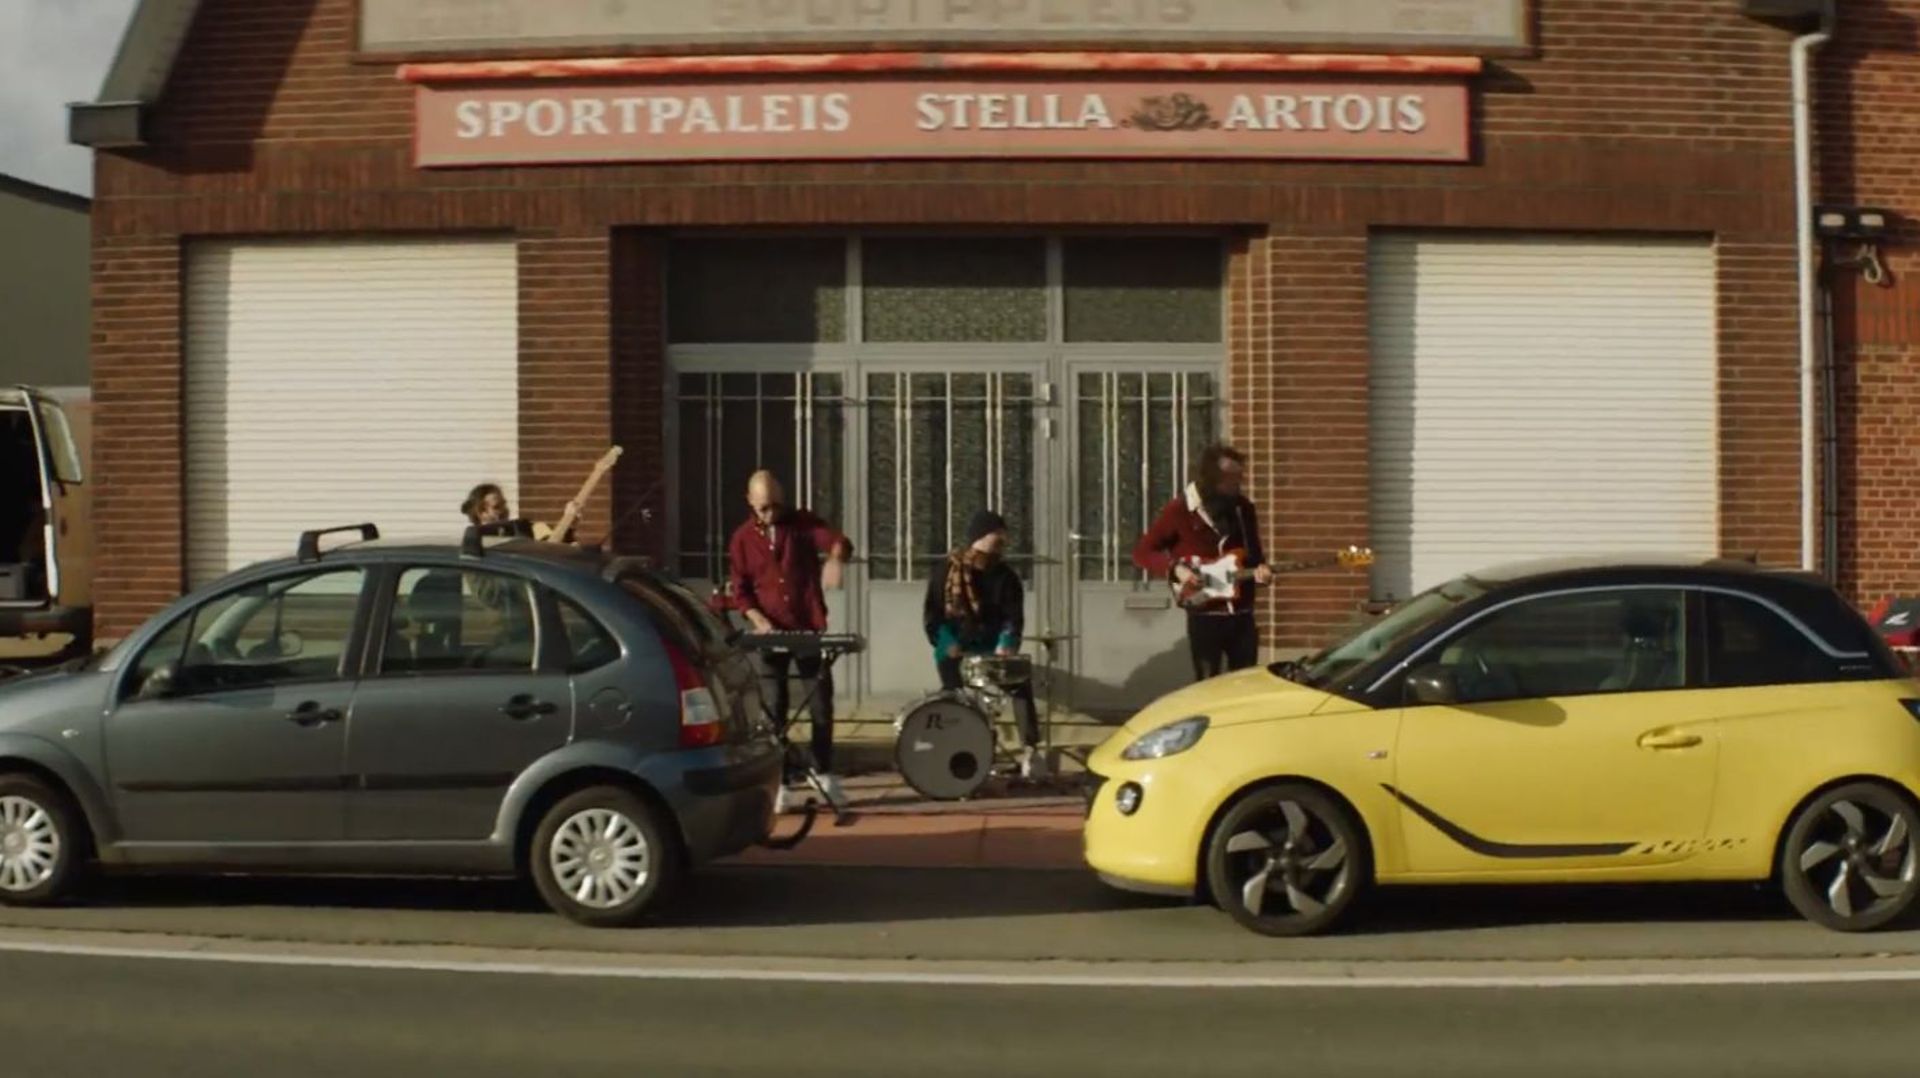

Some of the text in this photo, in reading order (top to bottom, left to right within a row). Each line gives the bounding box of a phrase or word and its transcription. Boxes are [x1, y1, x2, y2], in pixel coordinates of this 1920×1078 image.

[456, 93, 1425, 139] SPORTPALEIS STELLA ARTOIS
